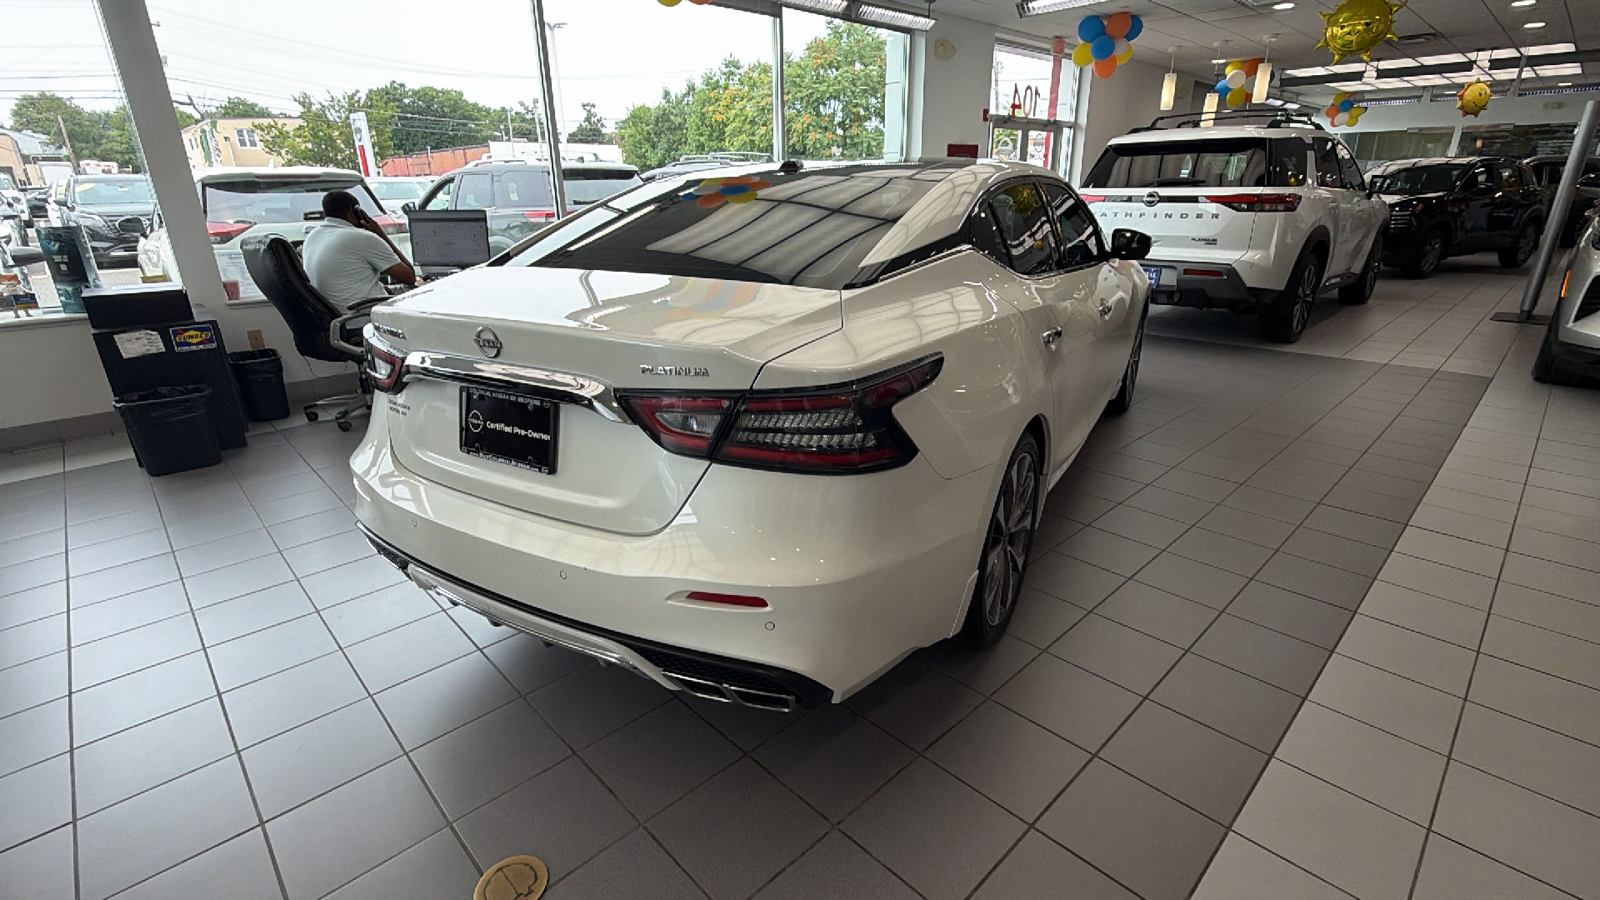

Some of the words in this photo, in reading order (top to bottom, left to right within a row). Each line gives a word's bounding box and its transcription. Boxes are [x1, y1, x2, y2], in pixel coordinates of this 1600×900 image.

[1094, 211, 1221, 220] ATHFINDER
[176, 332, 211, 342] SUNOCO
[639, 364, 710, 377] PLATINUM
[491, 391, 510, 400] NISSAN
[509, 394, 517, 402] OF
[486, 421, 513, 434] Certified
